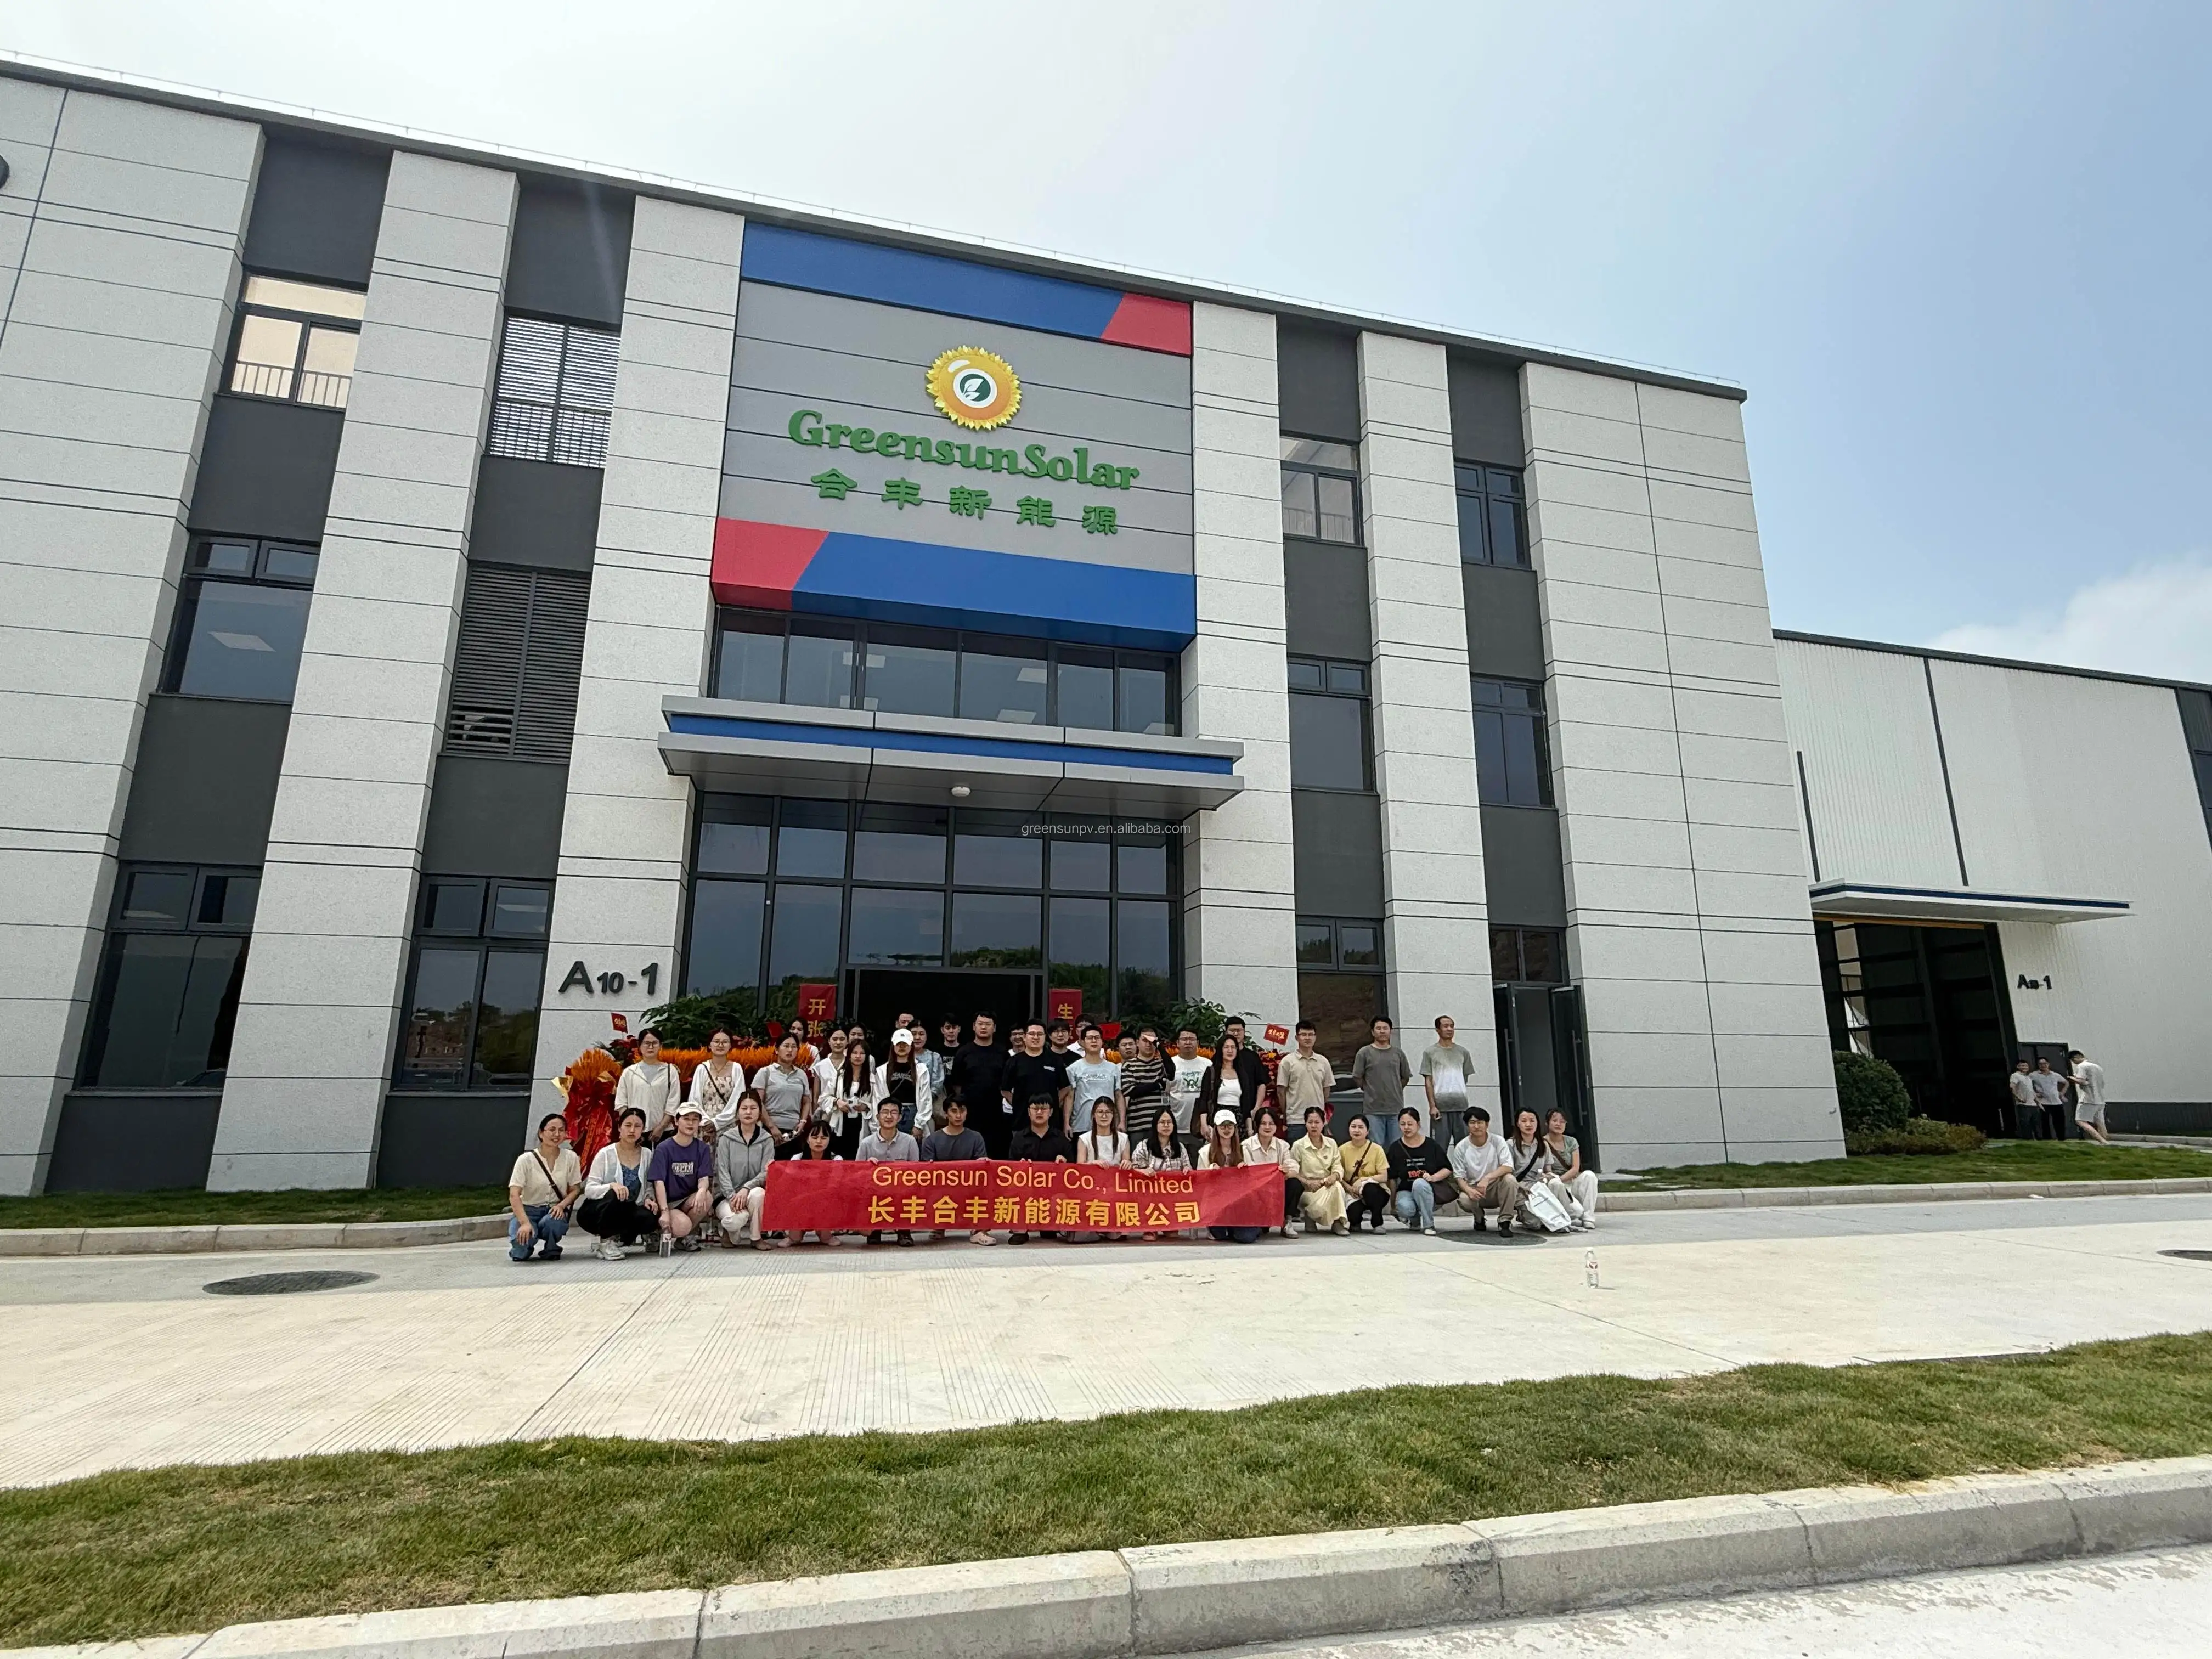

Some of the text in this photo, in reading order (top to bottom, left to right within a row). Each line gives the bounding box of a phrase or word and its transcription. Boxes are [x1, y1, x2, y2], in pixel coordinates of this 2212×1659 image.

[811, 468, 1119, 535] 合丰新能源
[558, 961, 658, 995] A10-1
[873, 1165, 1193, 1194] Greensun Solar Co., Limited
[868, 1195, 1200, 1227] 长丰合丰新能源有限公司
